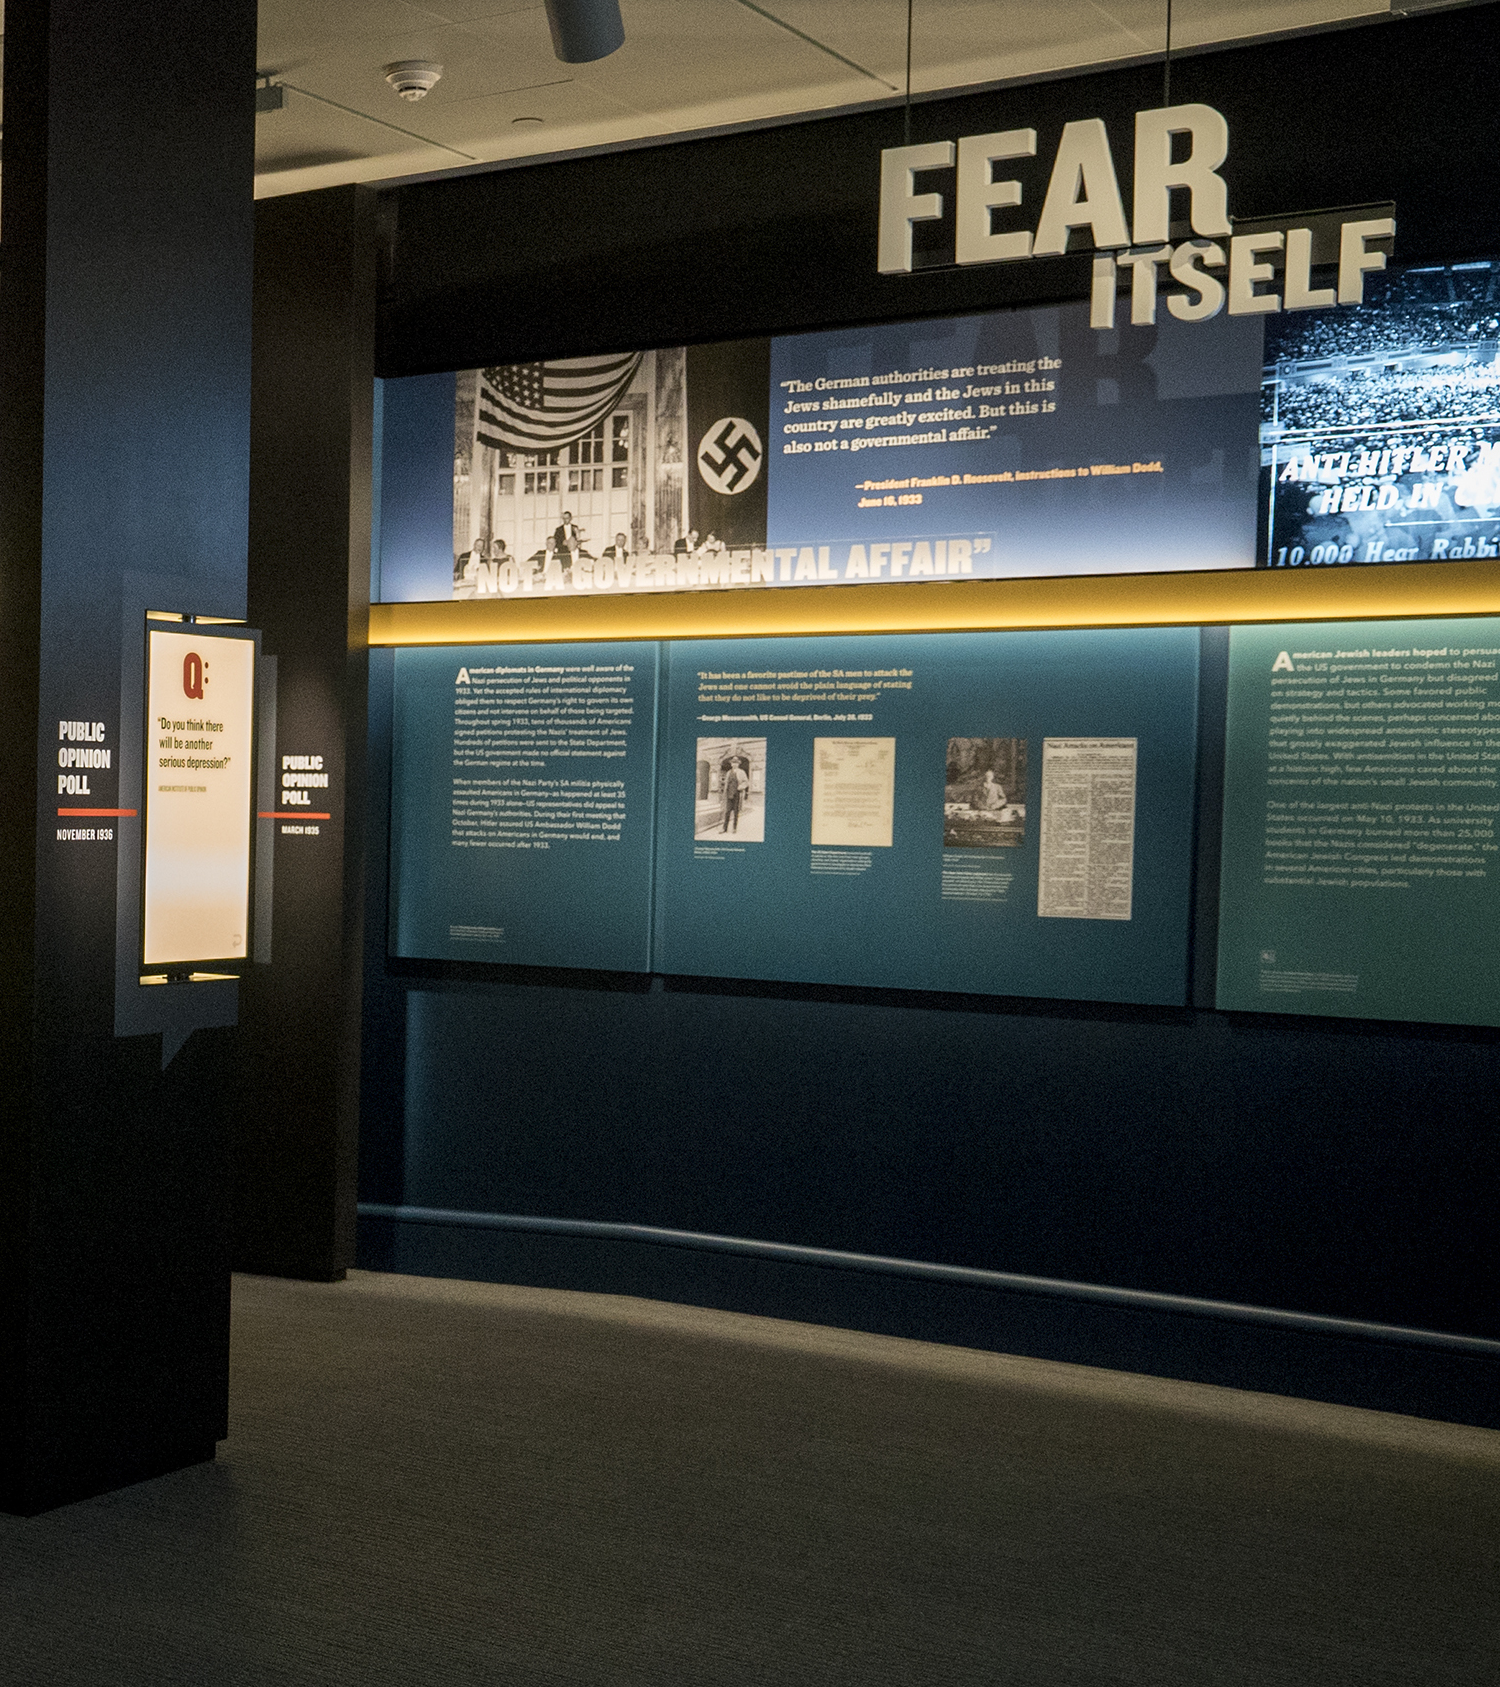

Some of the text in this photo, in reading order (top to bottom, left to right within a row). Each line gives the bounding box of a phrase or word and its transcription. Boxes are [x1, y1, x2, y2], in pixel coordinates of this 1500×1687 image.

[877, 102, 1233, 275] FEAR
[1090, 217, 1397, 330] ITSELF
[780, 356, 1062, 394] “The German authorities are treating the
[783, 378, 1055, 414] Jews shamefully and the Jews in this
[783, 399, 1056, 434] country are greatly excited. But this is
[783, 424, 998, 454] also not a governmental affair.”
[910, 476, 950, 488] Franklin
[950, 474, 962, 486] D.
[1078, 467, 1090, 477] to
[1090, 464, 1131, 476] William
[1132, 461, 1164, 473] Dodd,
[858, 497, 882, 508] June
[898, 494, 922, 506] 1933
[1319, 482, 1444, 514] HELD IN
[1365, 542, 1419, 562] Hear
[1430, 536, 1498, 560] Rabbi
[544, 558, 565, 591] A
[572, 546, 838, 590] GOVERNMENTAL
[845, 538, 992, 578] AFFAIR”
[1272, 650, 1332, 672] American
[1334, 649, 1370, 658] Jewish
[1372, 648, 1411, 658] leaders
[1412, 647, 1448, 658] hoped
[183, 652, 209, 700] Q:
[455, 667, 494, 684] American
[495, 666, 526, 675] diplomats
[534, 666, 564, 674] Germany
[582, 664, 594, 672] well
[708, 672, 722, 680] has
[747, 671, 776, 679] favorite
[778, 670, 808, 680] pastime
[809, 670, 818, 678] of
[818, 670, 832, 678] the
[832, 669, 844, 678] SA
[874, 668, 898, 677] attack
[899, 668, 913, 677] the
[718, 682, 733, 690] and
[777, 682, 798, 690] avoid
[800, 682, 813, 690] the
[814, 682, 835, 690] plain
[836, 681, 872, 690] language
[873, 680, 882, 688] of
[883, 681, 912, 689] stating
[714, 694, 730, 702] they
[756, 693, 771, 701] like
[792, 692, 826, 702] deprived
[827, 692, 836, 700] of
[837, 692, 856, 700] their
[59, 721, 106, 742] PUBLIC
[158, 717, 224, 732] “Do you think there
[159, 736, 212, 750] will be another
[58, 748, 111, 768] OPINION
[159, 756, 231, 770] serious depression?”
[282, 755, 324, 770] PUBLIC
[58, 774, 90, 795] POLL
[282, 772, 328, 788] OPINION
[282, 790, 311, 805] POLL
[56, 828, 114, 840] NOVEMBER 1936
[282, 826, 304, 834] MARCH
